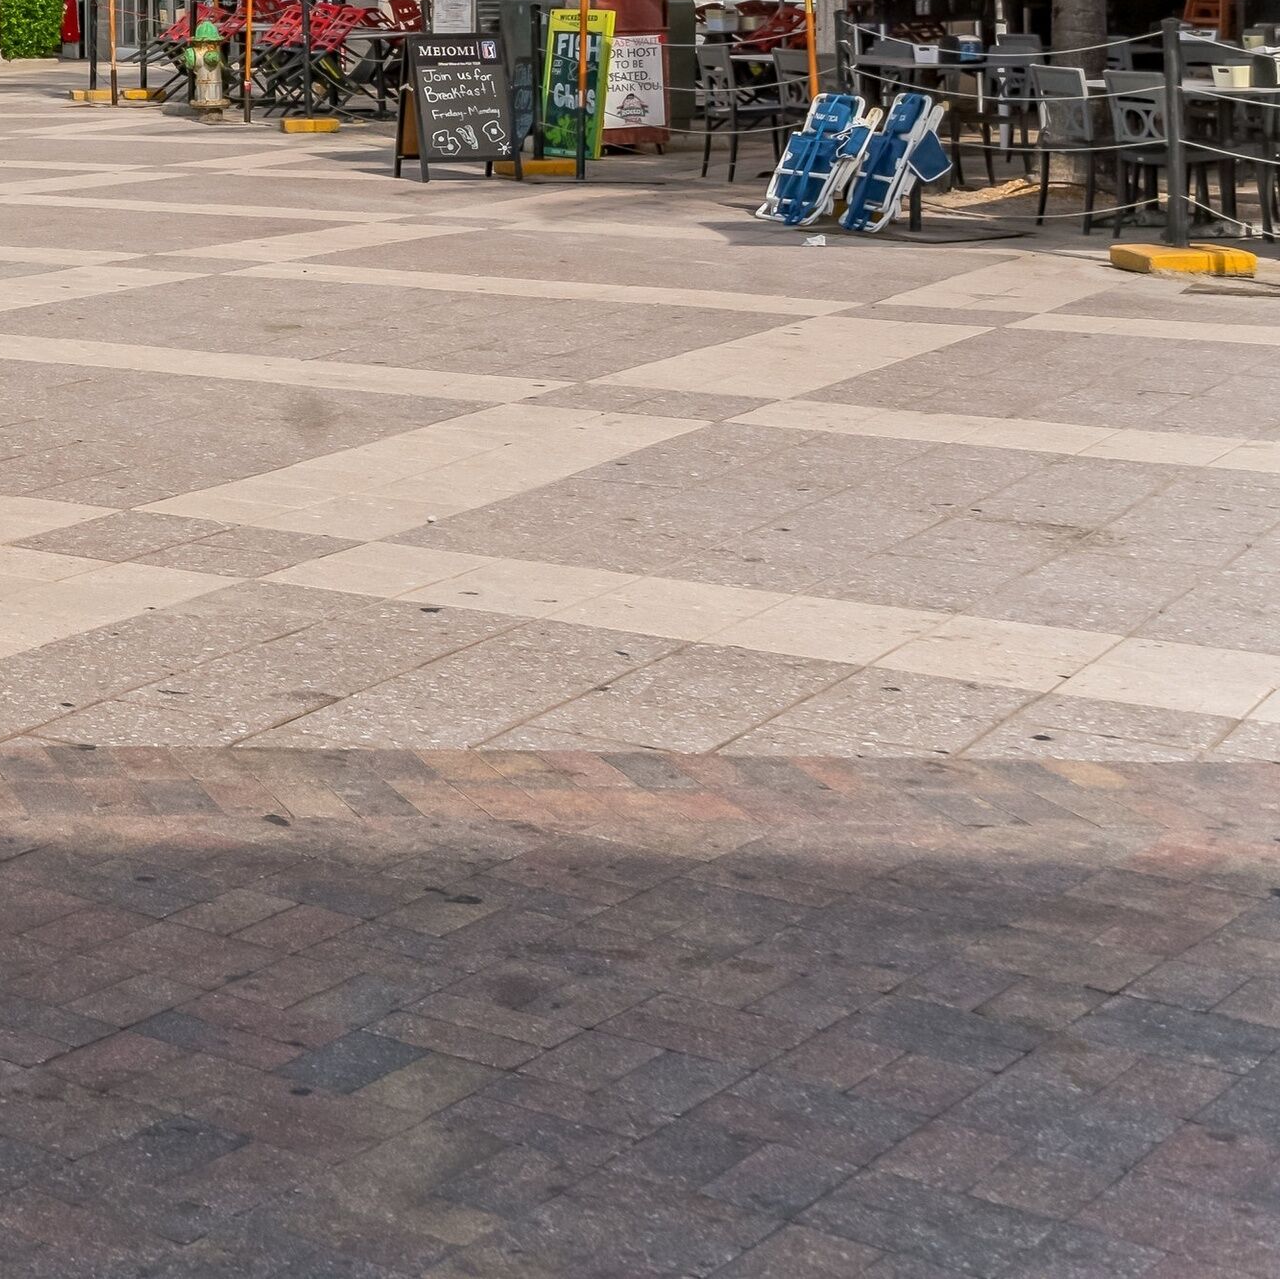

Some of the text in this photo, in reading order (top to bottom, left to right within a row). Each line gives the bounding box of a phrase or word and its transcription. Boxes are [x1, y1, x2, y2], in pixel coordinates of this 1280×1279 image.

[419, 45, 476, 56] MEIOMI
[611, 47, 658, 59] OR HOST
[615, 60, 644, 69] TO BE
[422, 68, 492, 82] Join us for
[609, 71, 651, 82] SEATED.
[608, 83, 636, 92] HANK
[554, 82, 596, 114] Chis
